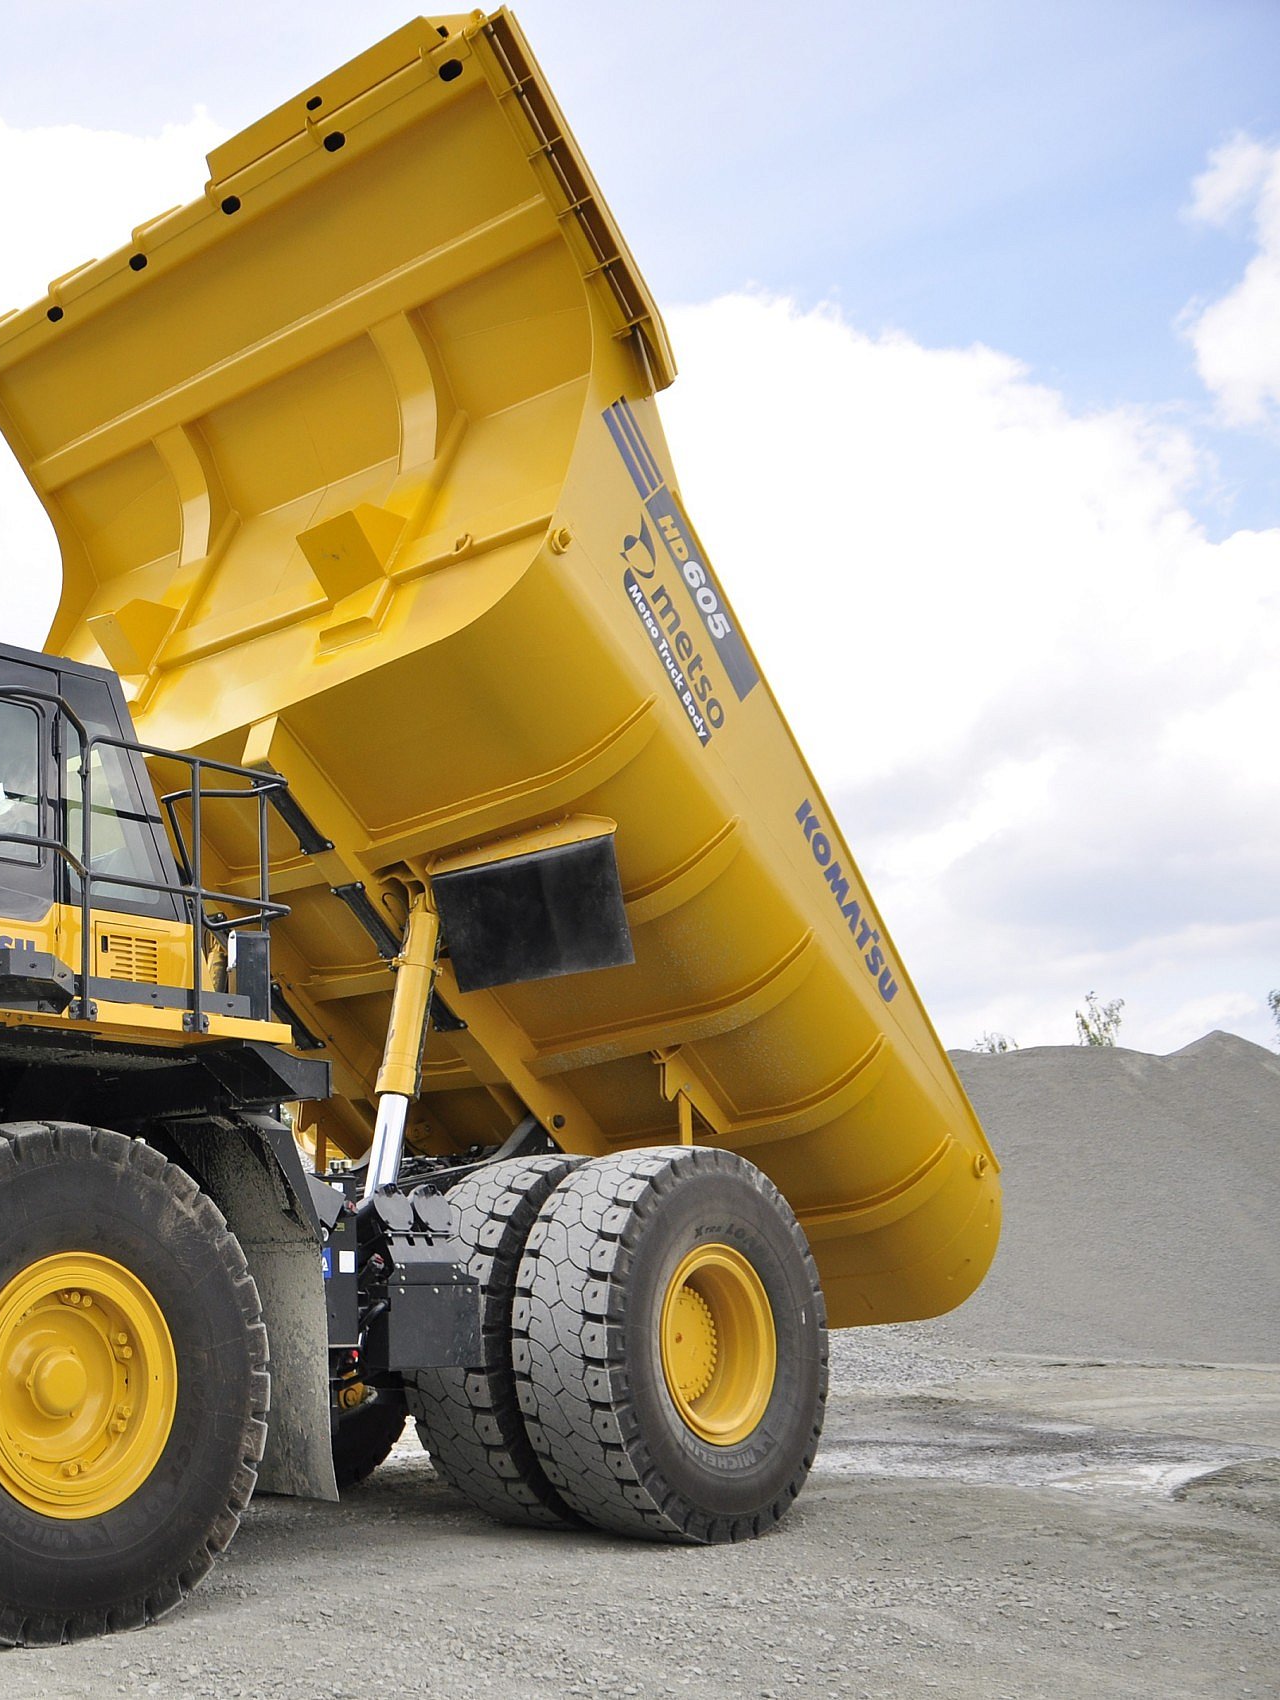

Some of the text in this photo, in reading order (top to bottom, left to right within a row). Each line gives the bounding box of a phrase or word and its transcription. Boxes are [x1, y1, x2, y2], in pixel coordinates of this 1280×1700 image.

[657, 514, 732, 639] HD605
[628, 584, 707, 737] Metso Truck Body
[650, 584, 725, 729] metso
[794, 798, 900, 1003] KOMATSU
[683, 1435, 757, 1471] MICHELIN
